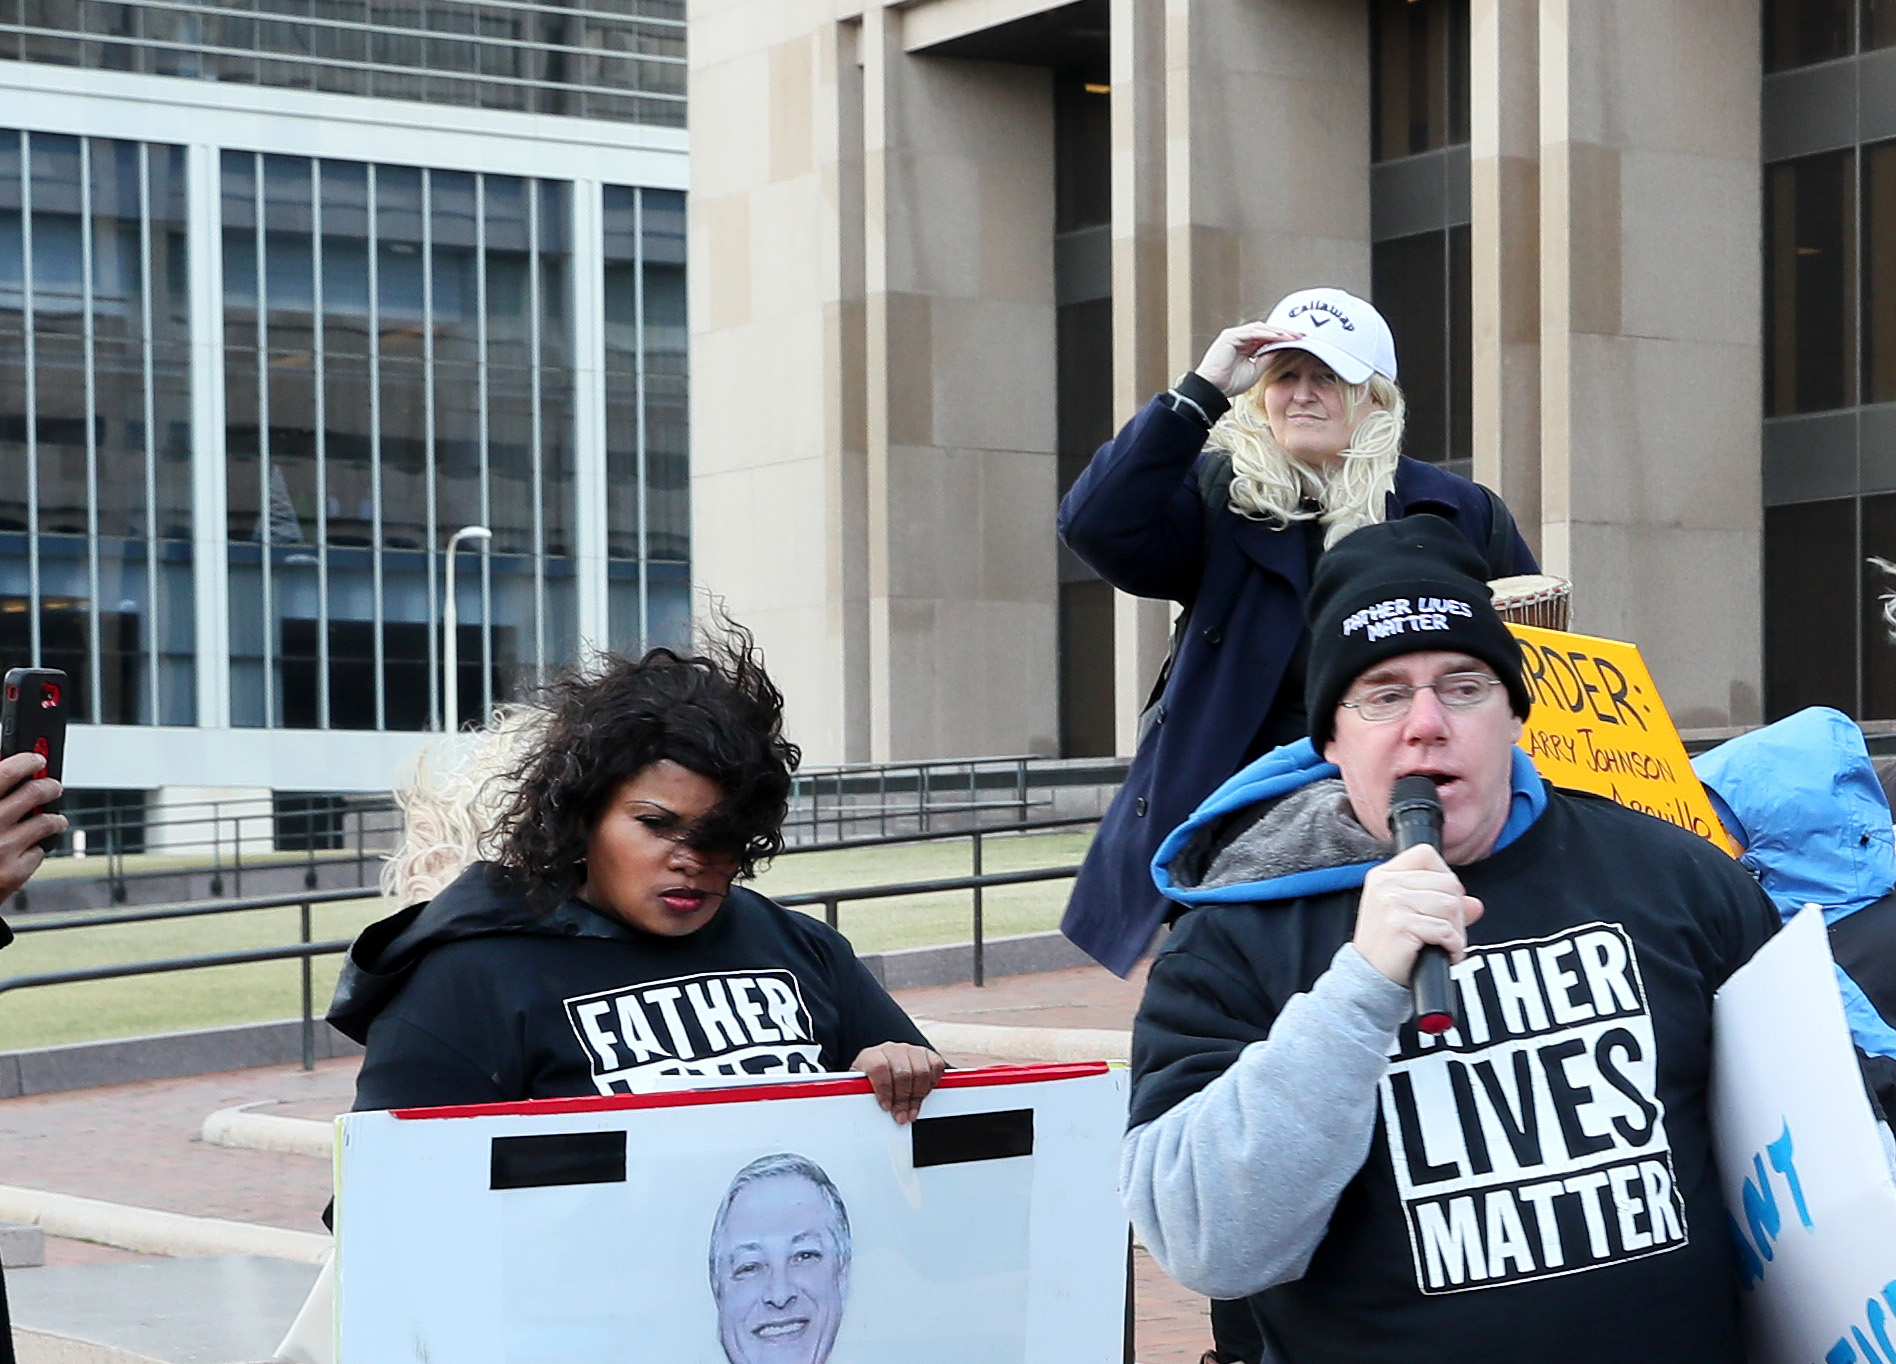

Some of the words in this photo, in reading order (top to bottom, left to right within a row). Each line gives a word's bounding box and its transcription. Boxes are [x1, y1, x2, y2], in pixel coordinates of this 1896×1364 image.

[1288, 300, 1356, 332] Callaway
[1342, 598, 1413, 637] FATHER
[1418, 597, 1473, 618] LIVES
[1366, 613, 1450, 642] MATTER
[1516, 638, 1652, 732] RDER:
[576, 977, 810, 1071] FATHER
[1389, 1027, 1658, 1187] LIVES
[1415, 1160, 1684, 1289] MATTER
